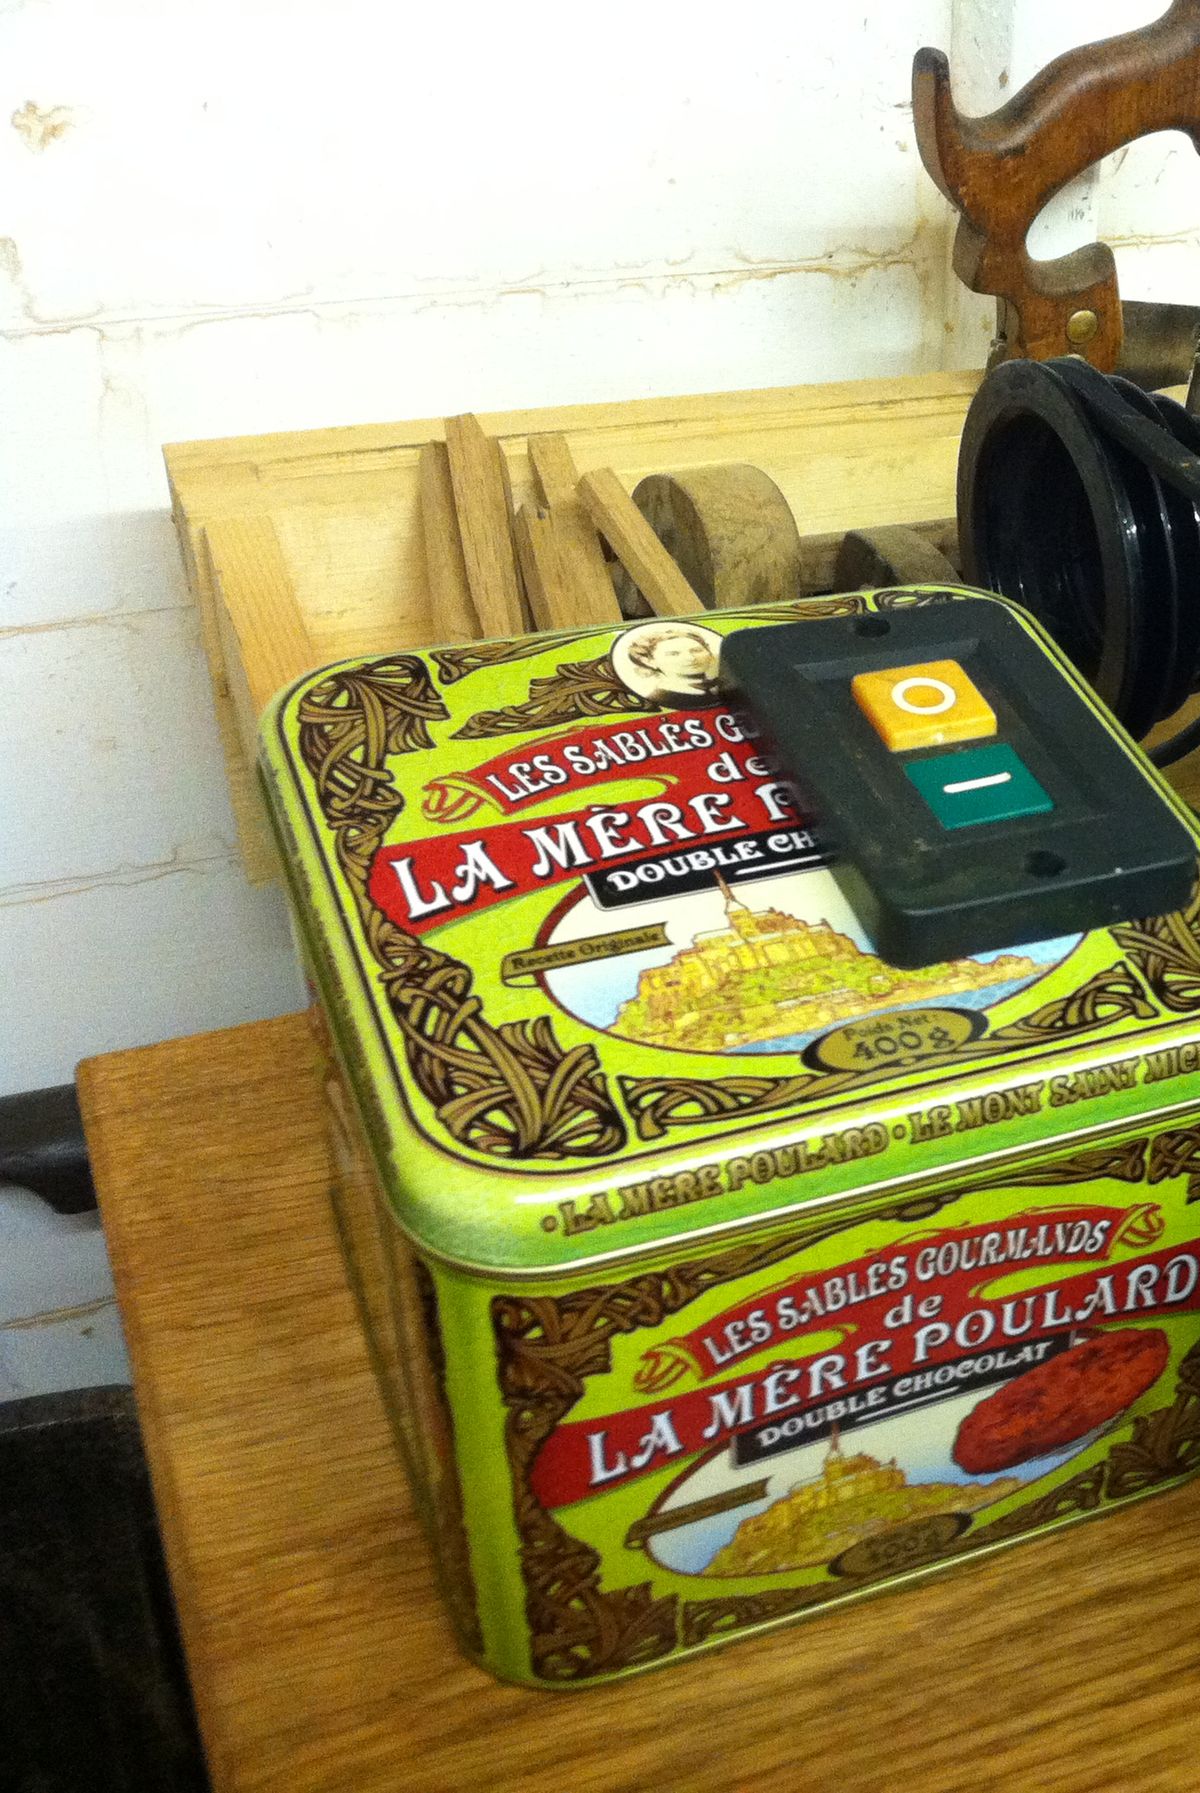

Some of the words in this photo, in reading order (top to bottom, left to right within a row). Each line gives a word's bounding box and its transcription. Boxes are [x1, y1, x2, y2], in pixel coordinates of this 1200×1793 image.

[485, 754, 568, 803] LES
[390, 840, 514, 921] LA
[522, 790, 749, 881] MÈRE
[606, 838, 765, 894] DOUBLE
[578, 931, 660, 957] Originale
[558, 1193, 617, 1237] LA
[724, 1121, 890, 1192] POULARD
[907, 1105, 956, 1144] LE
[955, 1080, 1046, 1131] MONT
[1048, 1056, 1140, 1106] SAINT
[701, 1309, 773, 1366] LES
[914, 1218, 1112, 1282] GOURMANDS
[883, 1290, 944, 1330] de
[587, 1412, 684, 1487] LA
[702, 1339, 894, 1440] MÈRE
[912, 1253, 1200, 1365] POULARD
[756, 1385, 888, 1448] DOUBLE
[891, 1340, 1052, 1399] CHOCOLAT
